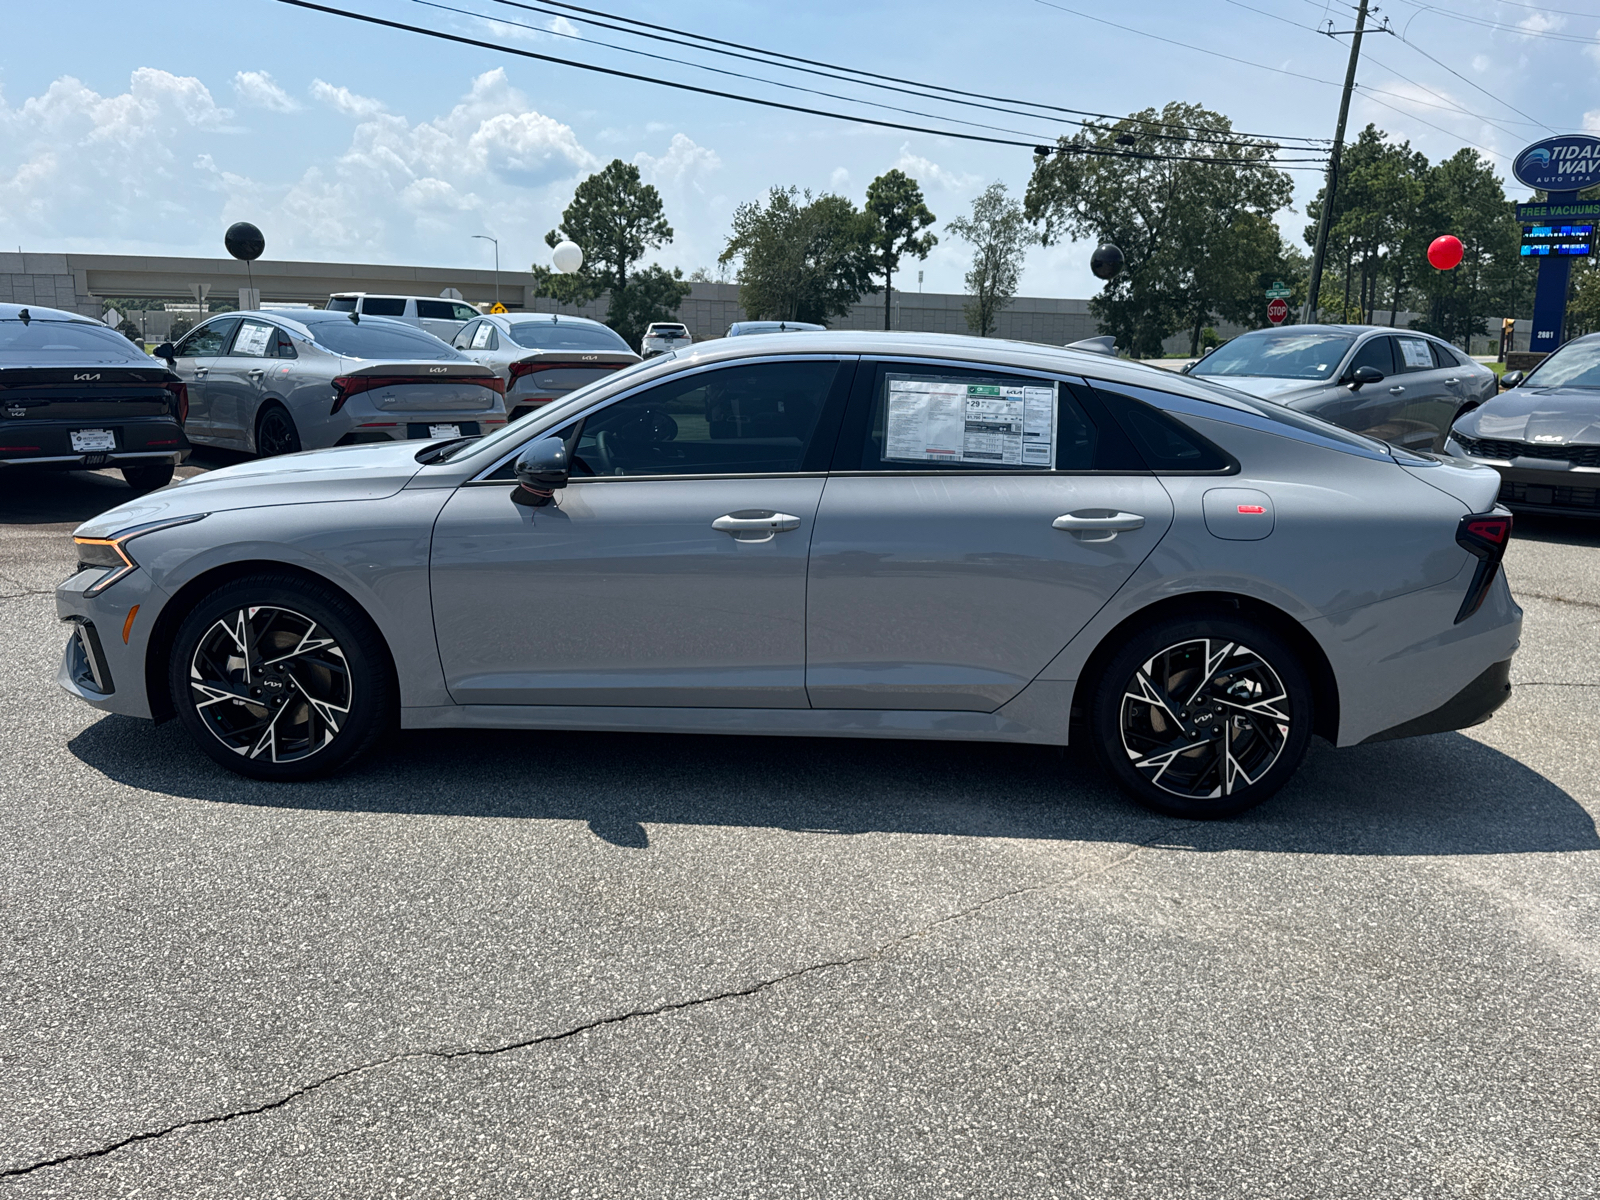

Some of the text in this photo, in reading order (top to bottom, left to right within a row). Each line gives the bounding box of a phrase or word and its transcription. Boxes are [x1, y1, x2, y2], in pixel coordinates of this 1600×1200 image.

[1552, 145, 1600, 160] TIDAL
[1558, 160, 1600, 174] WAV
[1520, 204, 1600, 217] FREE VACUUMS
[1269, 306, 1287, 316] STOP
[73, 373, 100, 381] KIA
